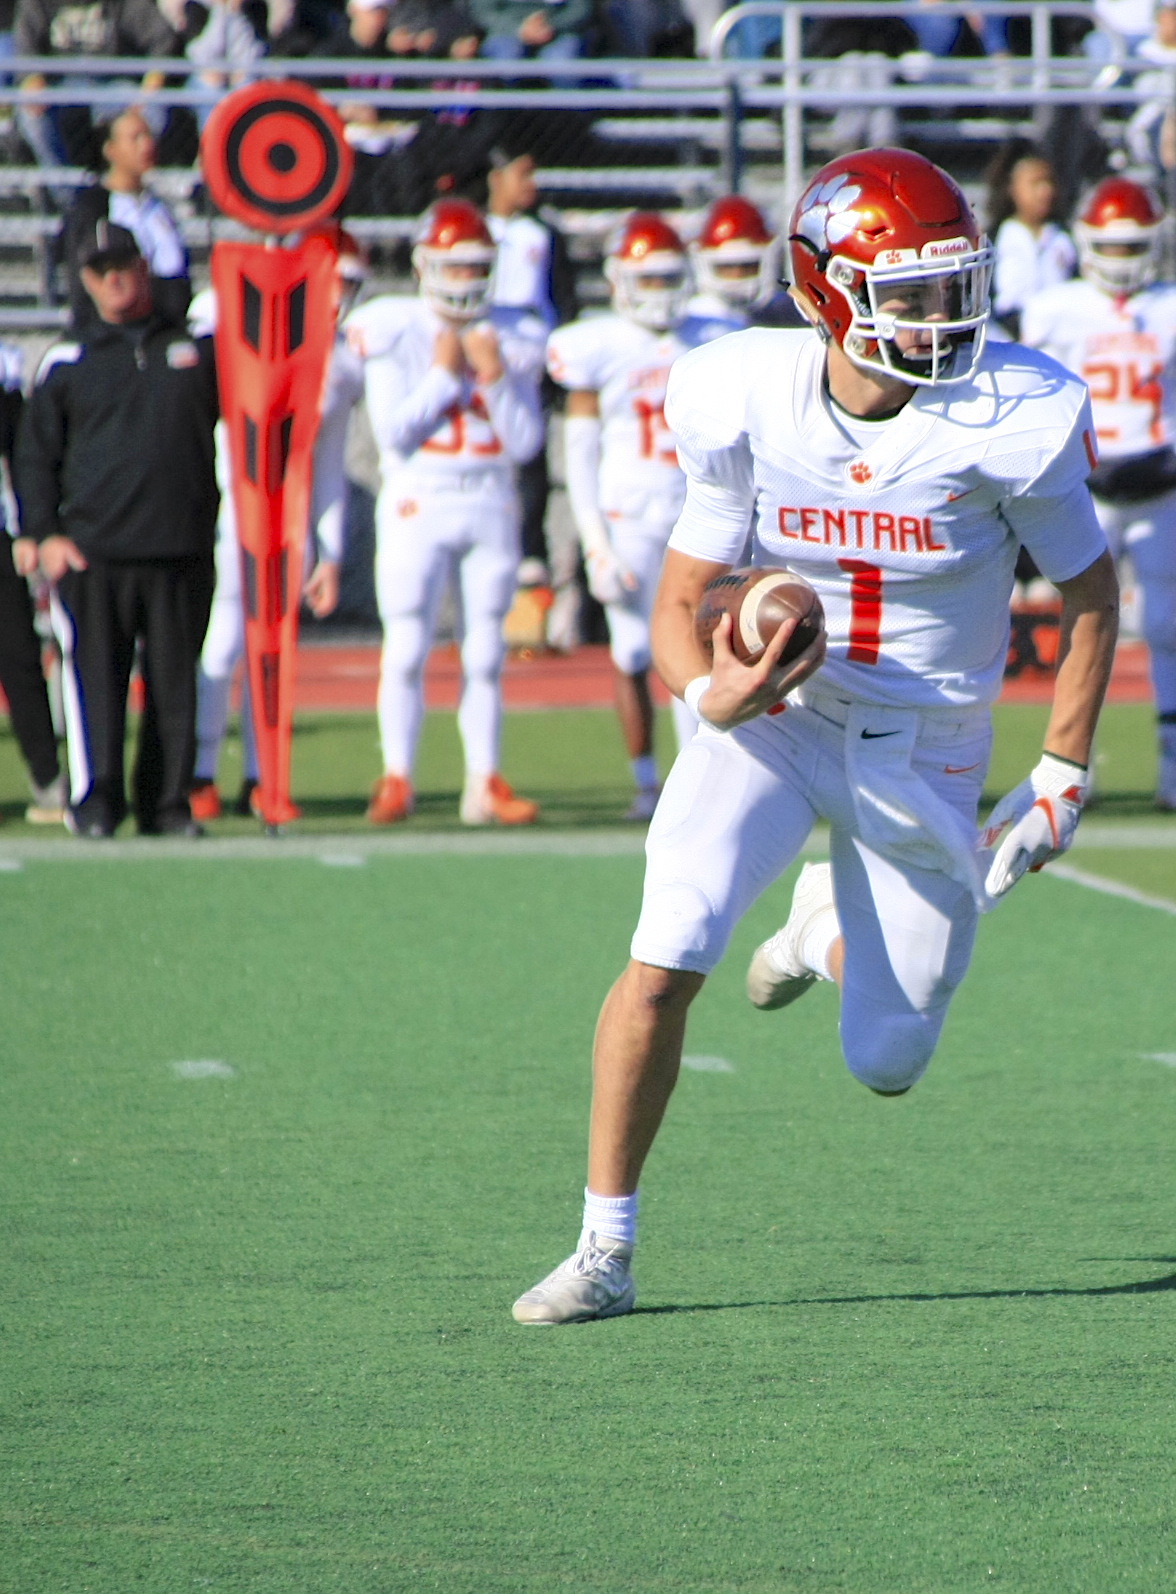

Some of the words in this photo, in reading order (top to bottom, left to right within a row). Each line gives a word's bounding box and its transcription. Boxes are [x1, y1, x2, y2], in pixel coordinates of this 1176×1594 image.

[929, 241, 968, 256] Riddell
[1083, 363, 1163, 444] 24
[778, 506, 946, 553] CENTRAL
[836, 558, 883, 666] 1
